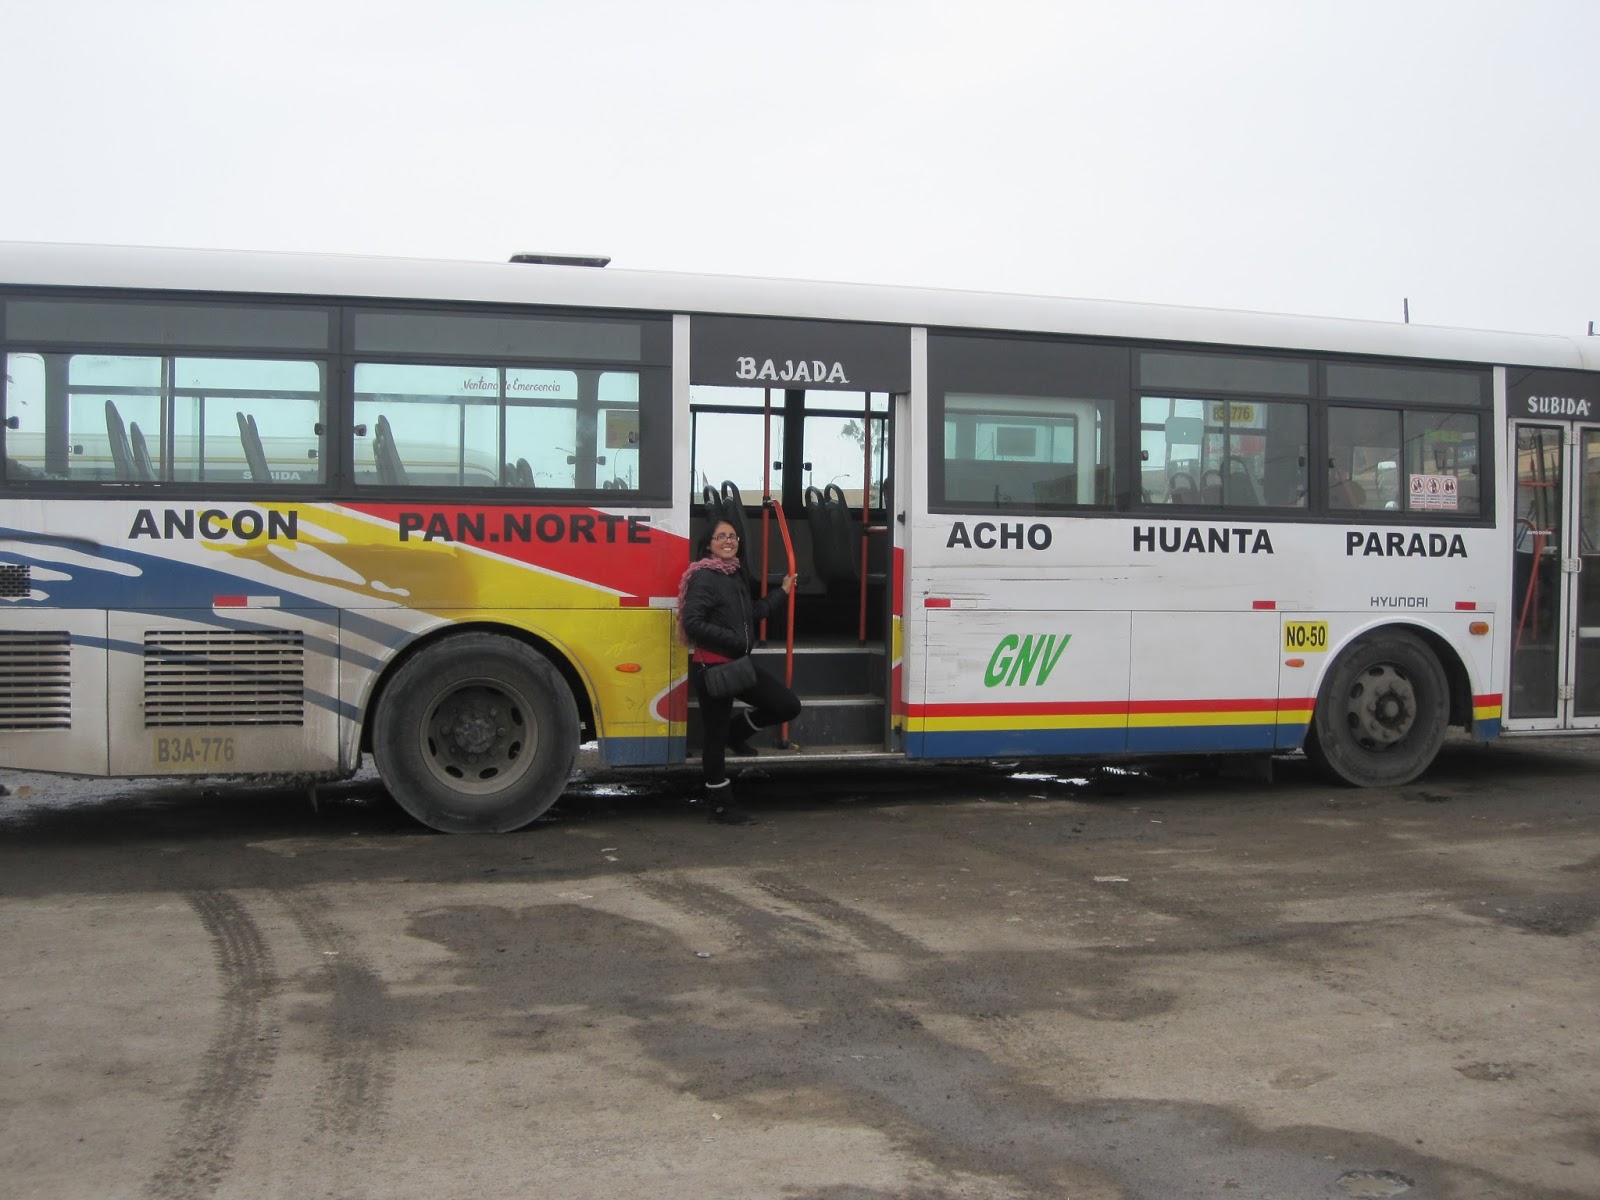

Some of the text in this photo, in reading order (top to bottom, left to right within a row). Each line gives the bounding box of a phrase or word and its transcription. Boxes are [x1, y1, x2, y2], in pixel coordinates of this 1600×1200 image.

[736, 356, 850, 384] BAJADA
[1527, 395, 1590, 416] SUBIDA
[128, 509, 298, 540] ANCON
[399, 512, 651, 544] PAN.NORTE
[946, 521, 1052, 551] ACHO
[1132, 526, 1274, 554] HUANTA
[1346, 531, 1468, 558] PARADA
[1370, 596, 1428, 608] HYUNDAI
[1286, 625, 1326, 647] NO-50
[983, 633, 1072, 688] GNV
[158, 737, 234, 762] B3A-776
